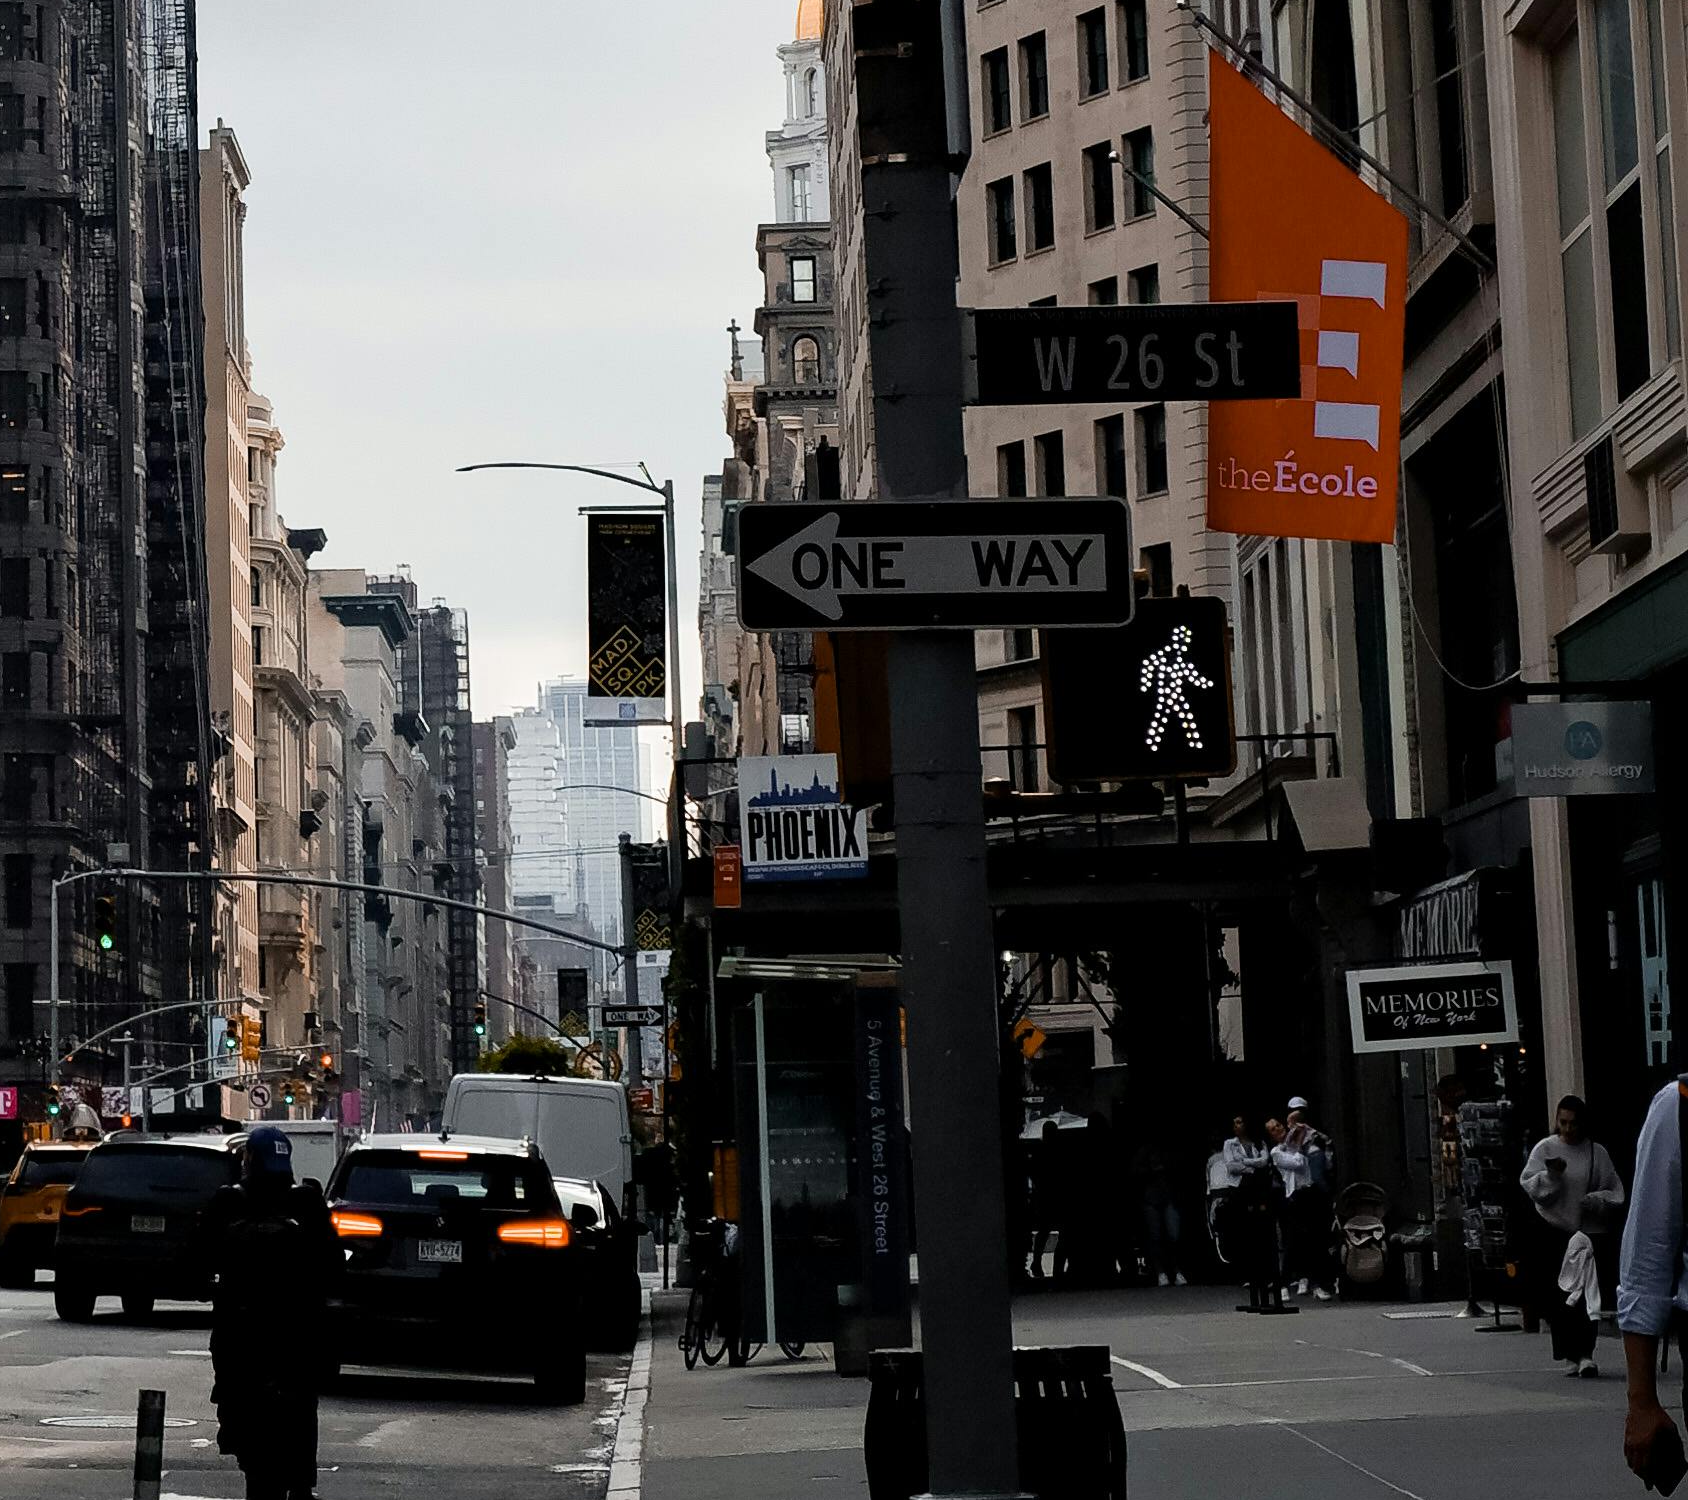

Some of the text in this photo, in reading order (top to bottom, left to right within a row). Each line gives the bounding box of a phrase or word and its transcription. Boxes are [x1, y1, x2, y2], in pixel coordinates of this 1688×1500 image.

[1033, 330, 1246, 391] W 26 St
[792, 539, 1094, 590] ONE WAY
[1524, 764, 1584, 778] Hudson
[748, 807, 861, 862] PHOENIX
[637, 1012, 656, 1021] WAY
[1365, 987, 1500, 1015] MEMORIES
[1393, 1011, 1477, 1029] Of New York
[866, 1020, 890, 1256] 5 Avenue & West 26 Street
